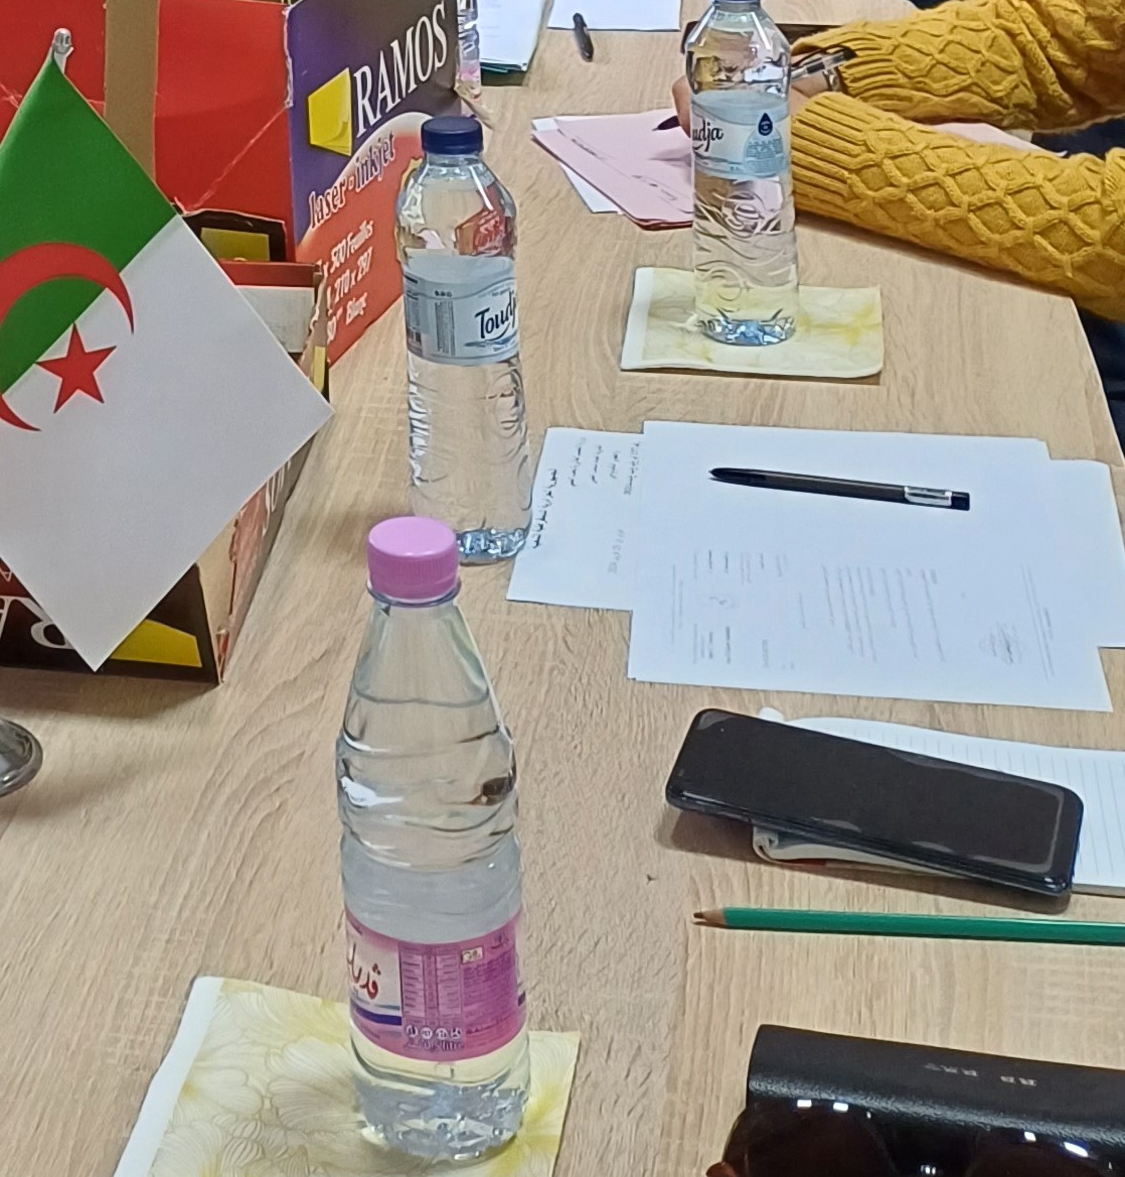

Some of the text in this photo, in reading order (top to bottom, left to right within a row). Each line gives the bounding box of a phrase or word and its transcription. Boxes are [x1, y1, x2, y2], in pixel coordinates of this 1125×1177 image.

[353, 0, 448, 139] RAMOS
[309, 130, 396, 231] laser inkjet
[692, 119, 724, 152] udja
